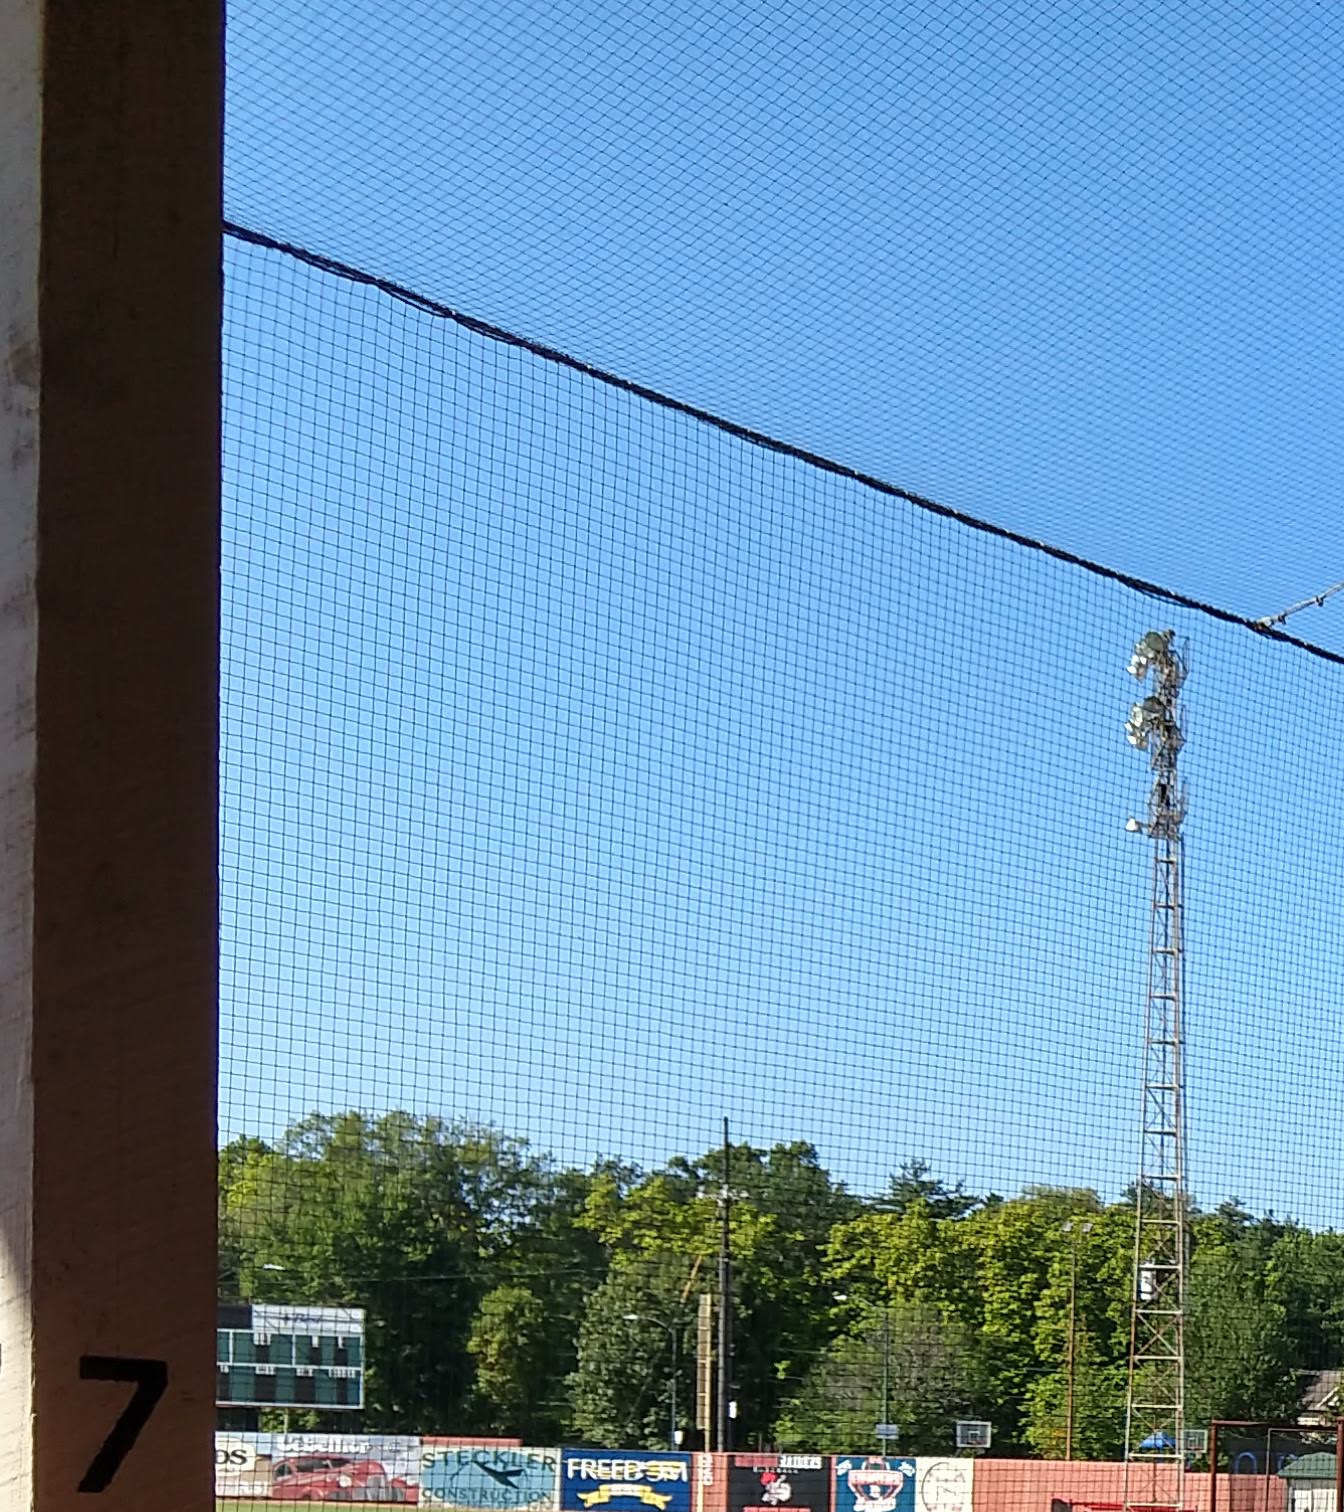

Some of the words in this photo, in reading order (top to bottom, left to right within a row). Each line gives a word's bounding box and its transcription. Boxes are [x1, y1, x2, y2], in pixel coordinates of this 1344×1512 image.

[77, 1355, 168, 1493] 7
[422, 1450, 557, 1472] STECKLER
[422, 1487, 554, 1504] CONSTRUCTION
